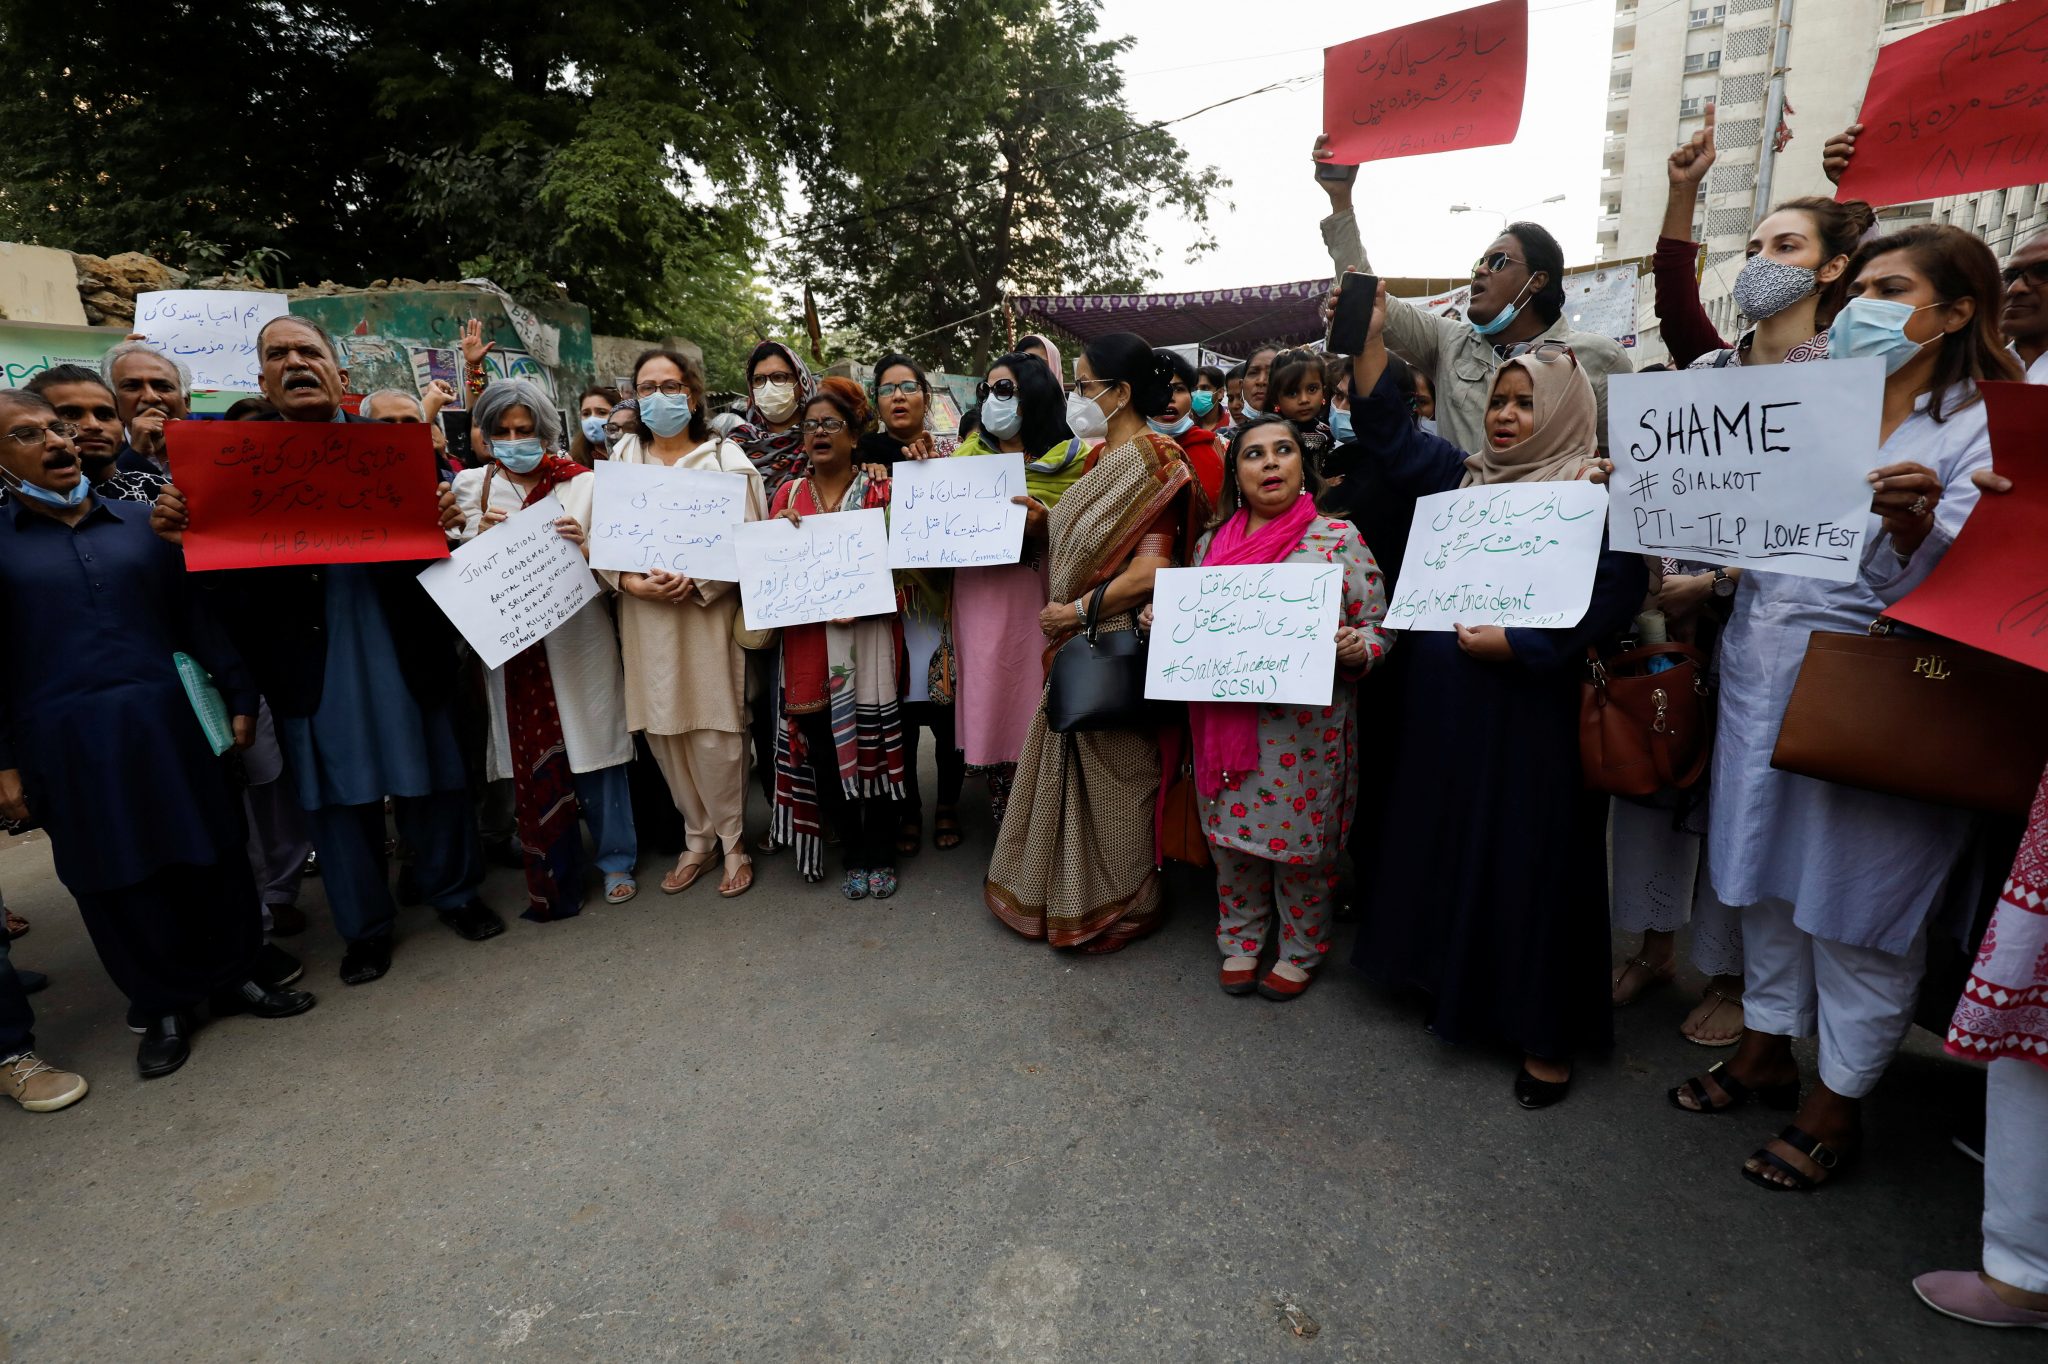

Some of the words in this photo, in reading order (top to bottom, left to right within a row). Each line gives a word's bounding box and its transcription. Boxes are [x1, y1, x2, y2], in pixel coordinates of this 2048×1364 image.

[1630, 401, 1802, 462] SHAME
[1672, 467, 1762, 495] SIALKOT
[459, 552, 499, 584] JOINT
[506, 533, 537, 556] ACTION
[501, 543, 550, 580] CONDEMNS
[548, 559, 576, 584] NATIONAL
[634, 546, 689, 571] JAC
[490, 583, 520, 603] BRUTAL
[522, 555, 557, 582] LYNCHING
[499, 626, 520, 645] STOP
[525, 602, 560, 628] KILLING
[511, 612, 522, 623] IN
[801, 604, 845, 621] JAC
[512, 630, 536, 648] NAME
[544, 619, 552, 630] OF
